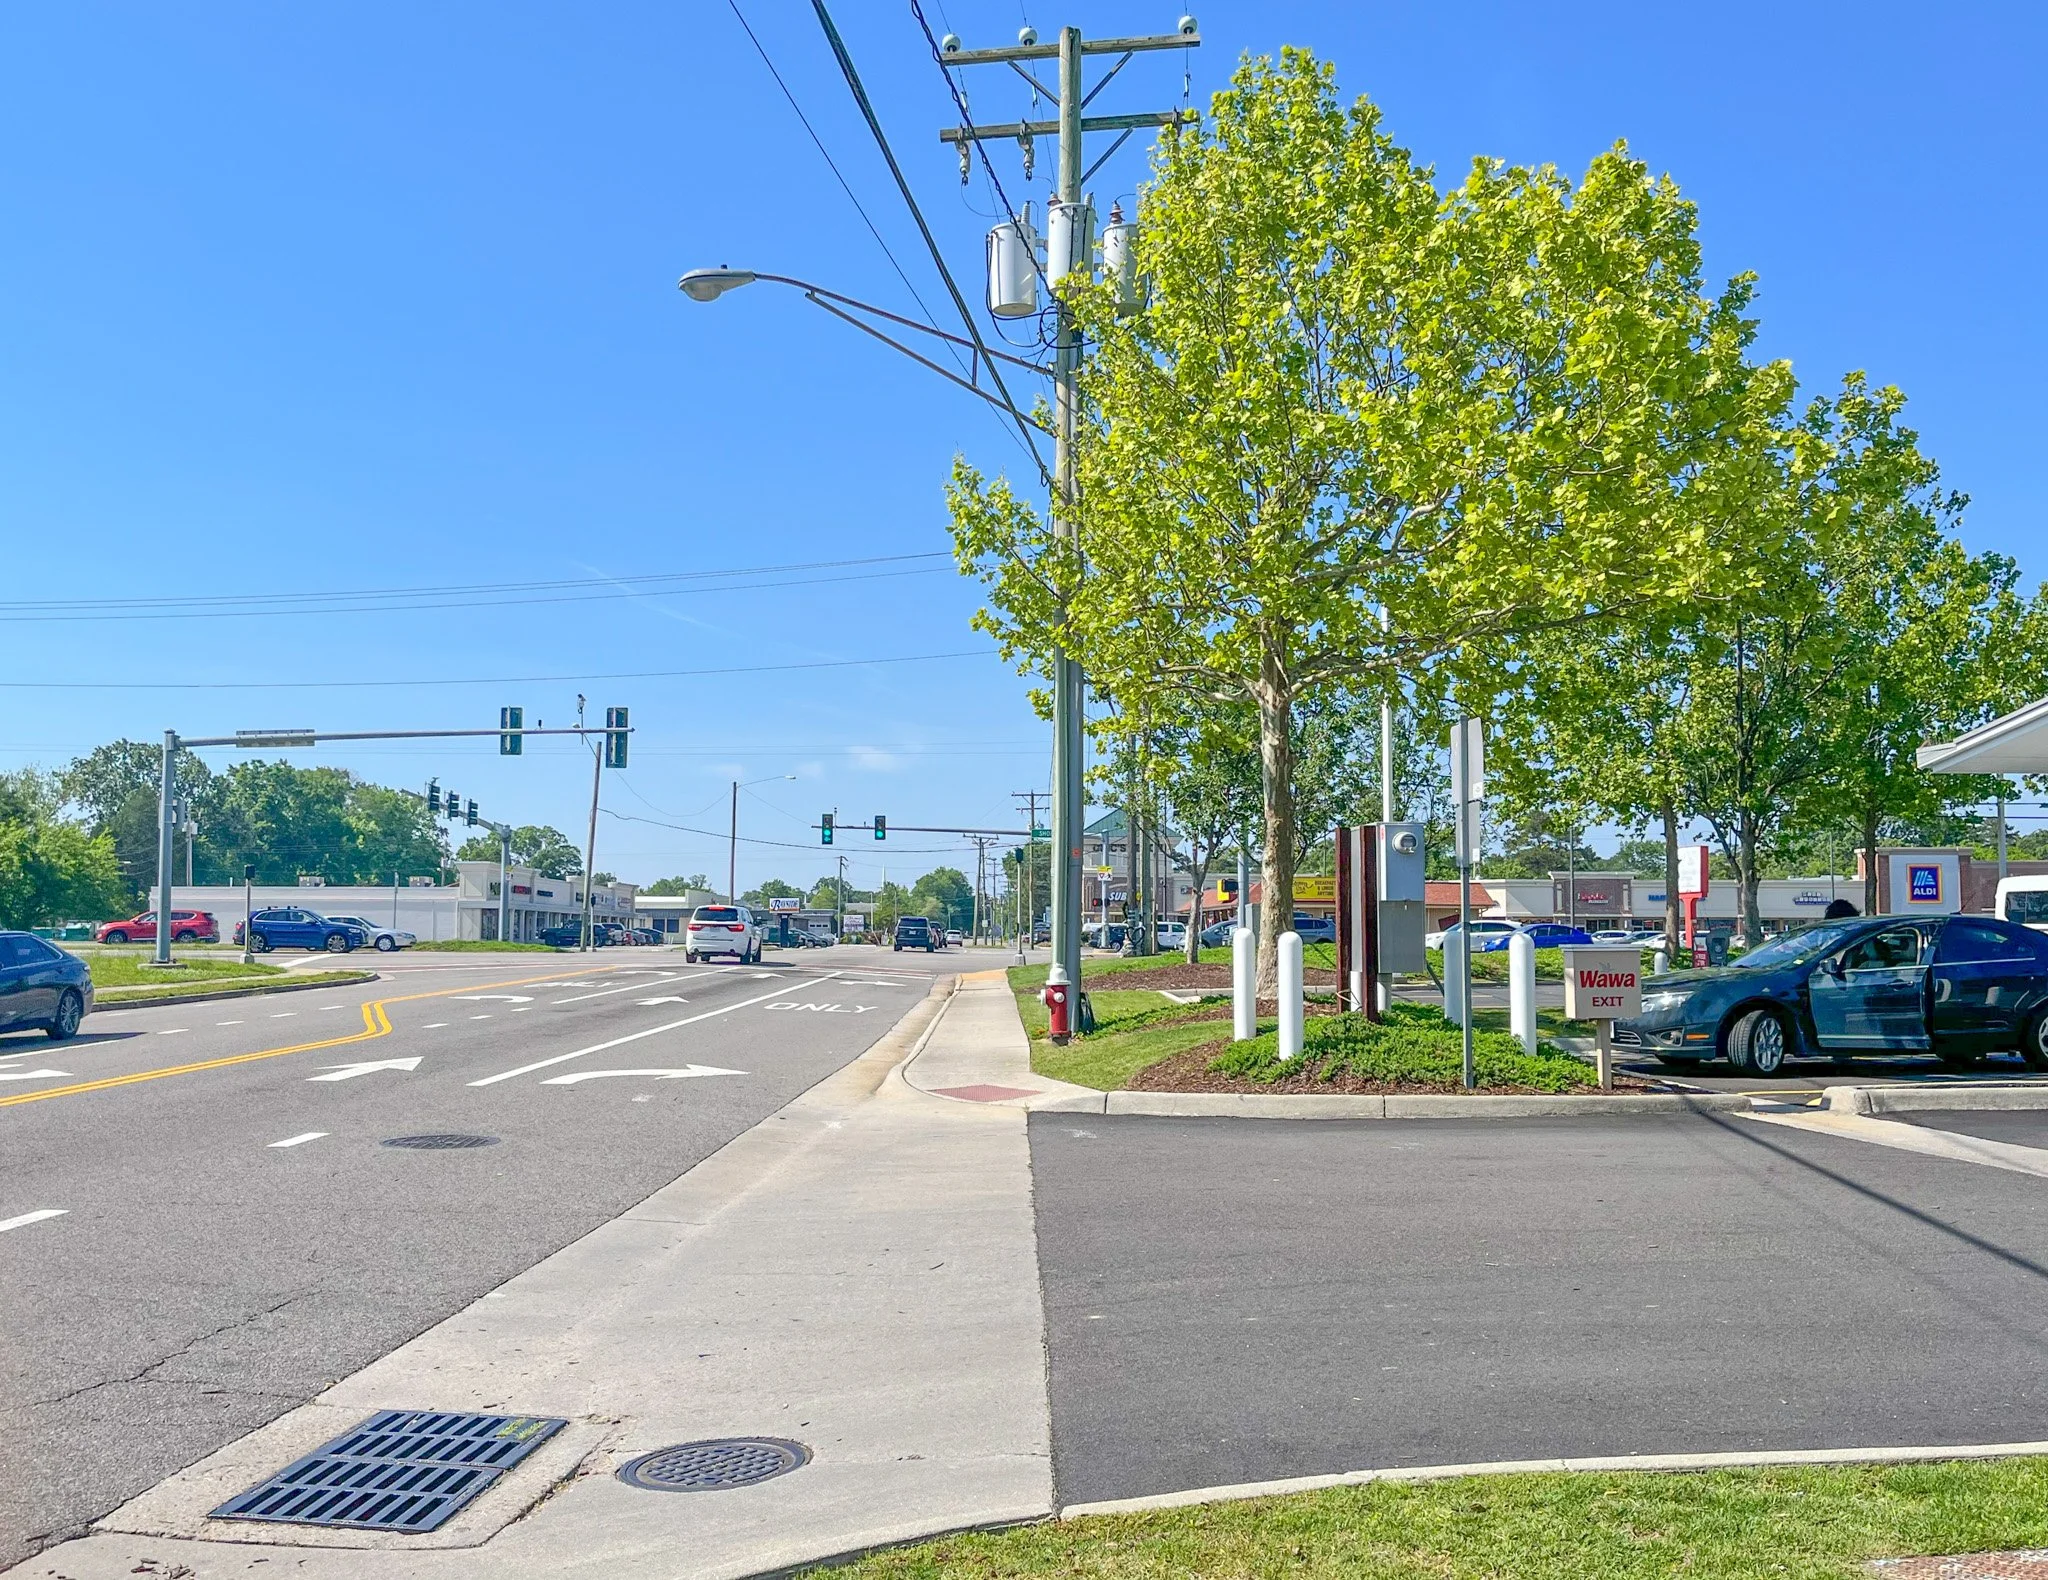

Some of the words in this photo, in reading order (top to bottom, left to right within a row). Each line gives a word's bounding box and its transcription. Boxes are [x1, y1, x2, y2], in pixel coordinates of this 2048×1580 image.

[1108, 892, 1128, 901] SUB
[1913, 888, 1936, 896] ALDI
[1579, 970, 1636, 988] Wawa
[1592, 996, 1624, 1007] EXIT
[763, 1001, 879, 1014] ONLY
